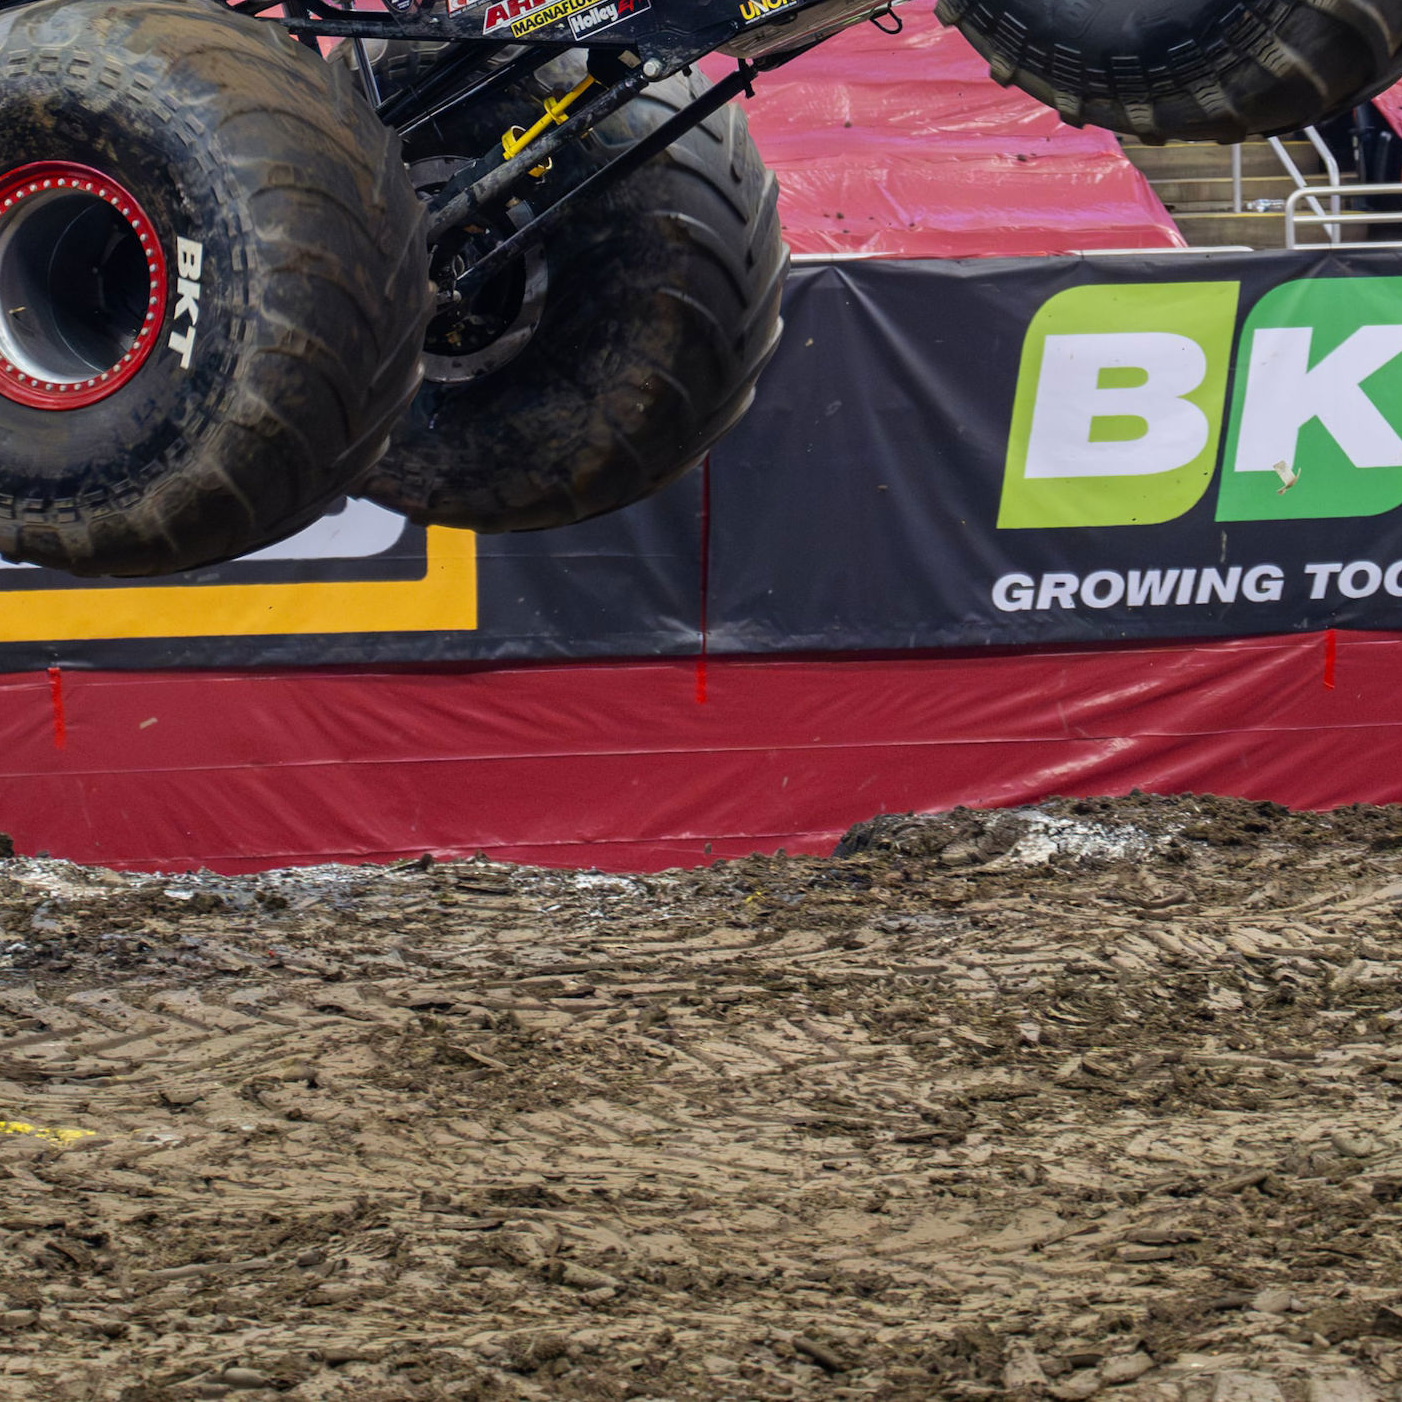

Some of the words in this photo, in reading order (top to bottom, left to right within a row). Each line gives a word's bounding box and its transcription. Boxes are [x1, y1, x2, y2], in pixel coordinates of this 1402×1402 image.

[570, 2, 618, 34] Holley
[168, 236, 203, 370] BKT
[991, 565, 1285, 612] GROWING
